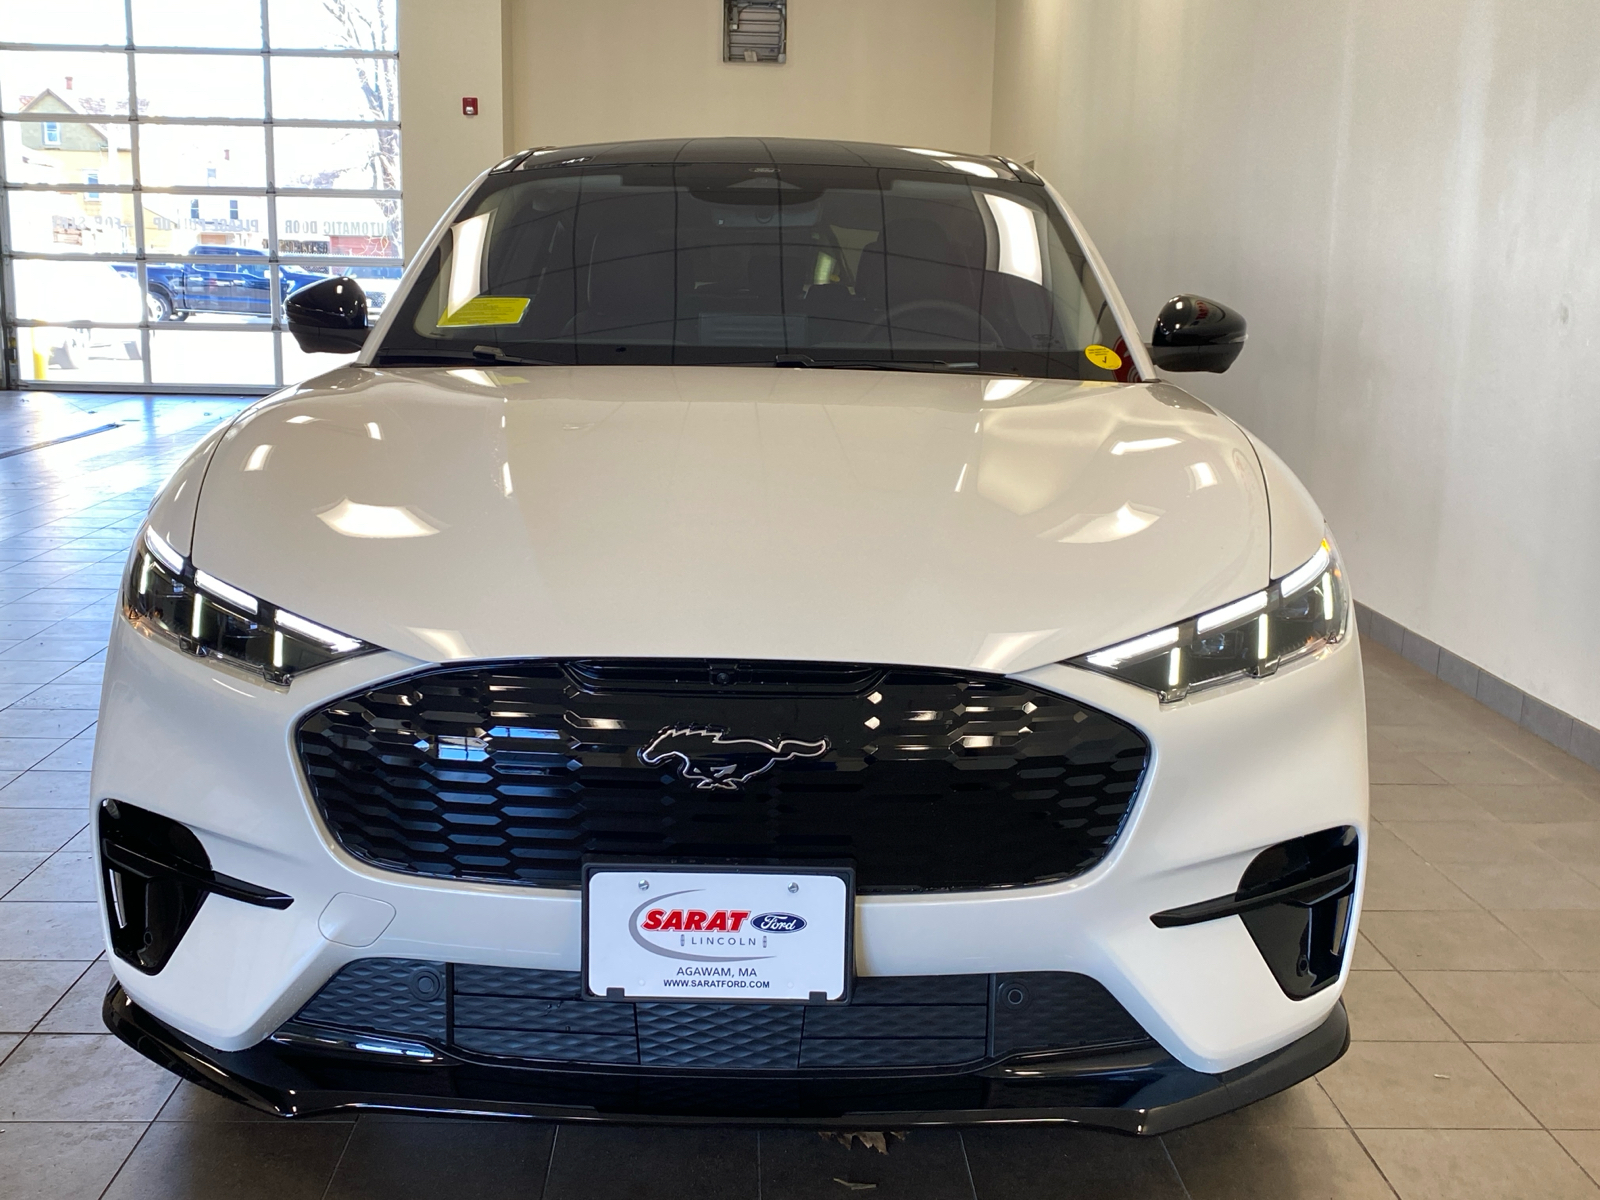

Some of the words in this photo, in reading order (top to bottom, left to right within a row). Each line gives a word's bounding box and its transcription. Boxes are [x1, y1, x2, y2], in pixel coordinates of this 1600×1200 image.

[640, 908, 752, 934] SARAT
[691, 936, 757, 947] LINCOLN
[676, 966, 735, 979] AGAWAM,
[738, 967, 758, 978] MA
[663, 979, 770, 990] WWW.SARATFORD.COM
